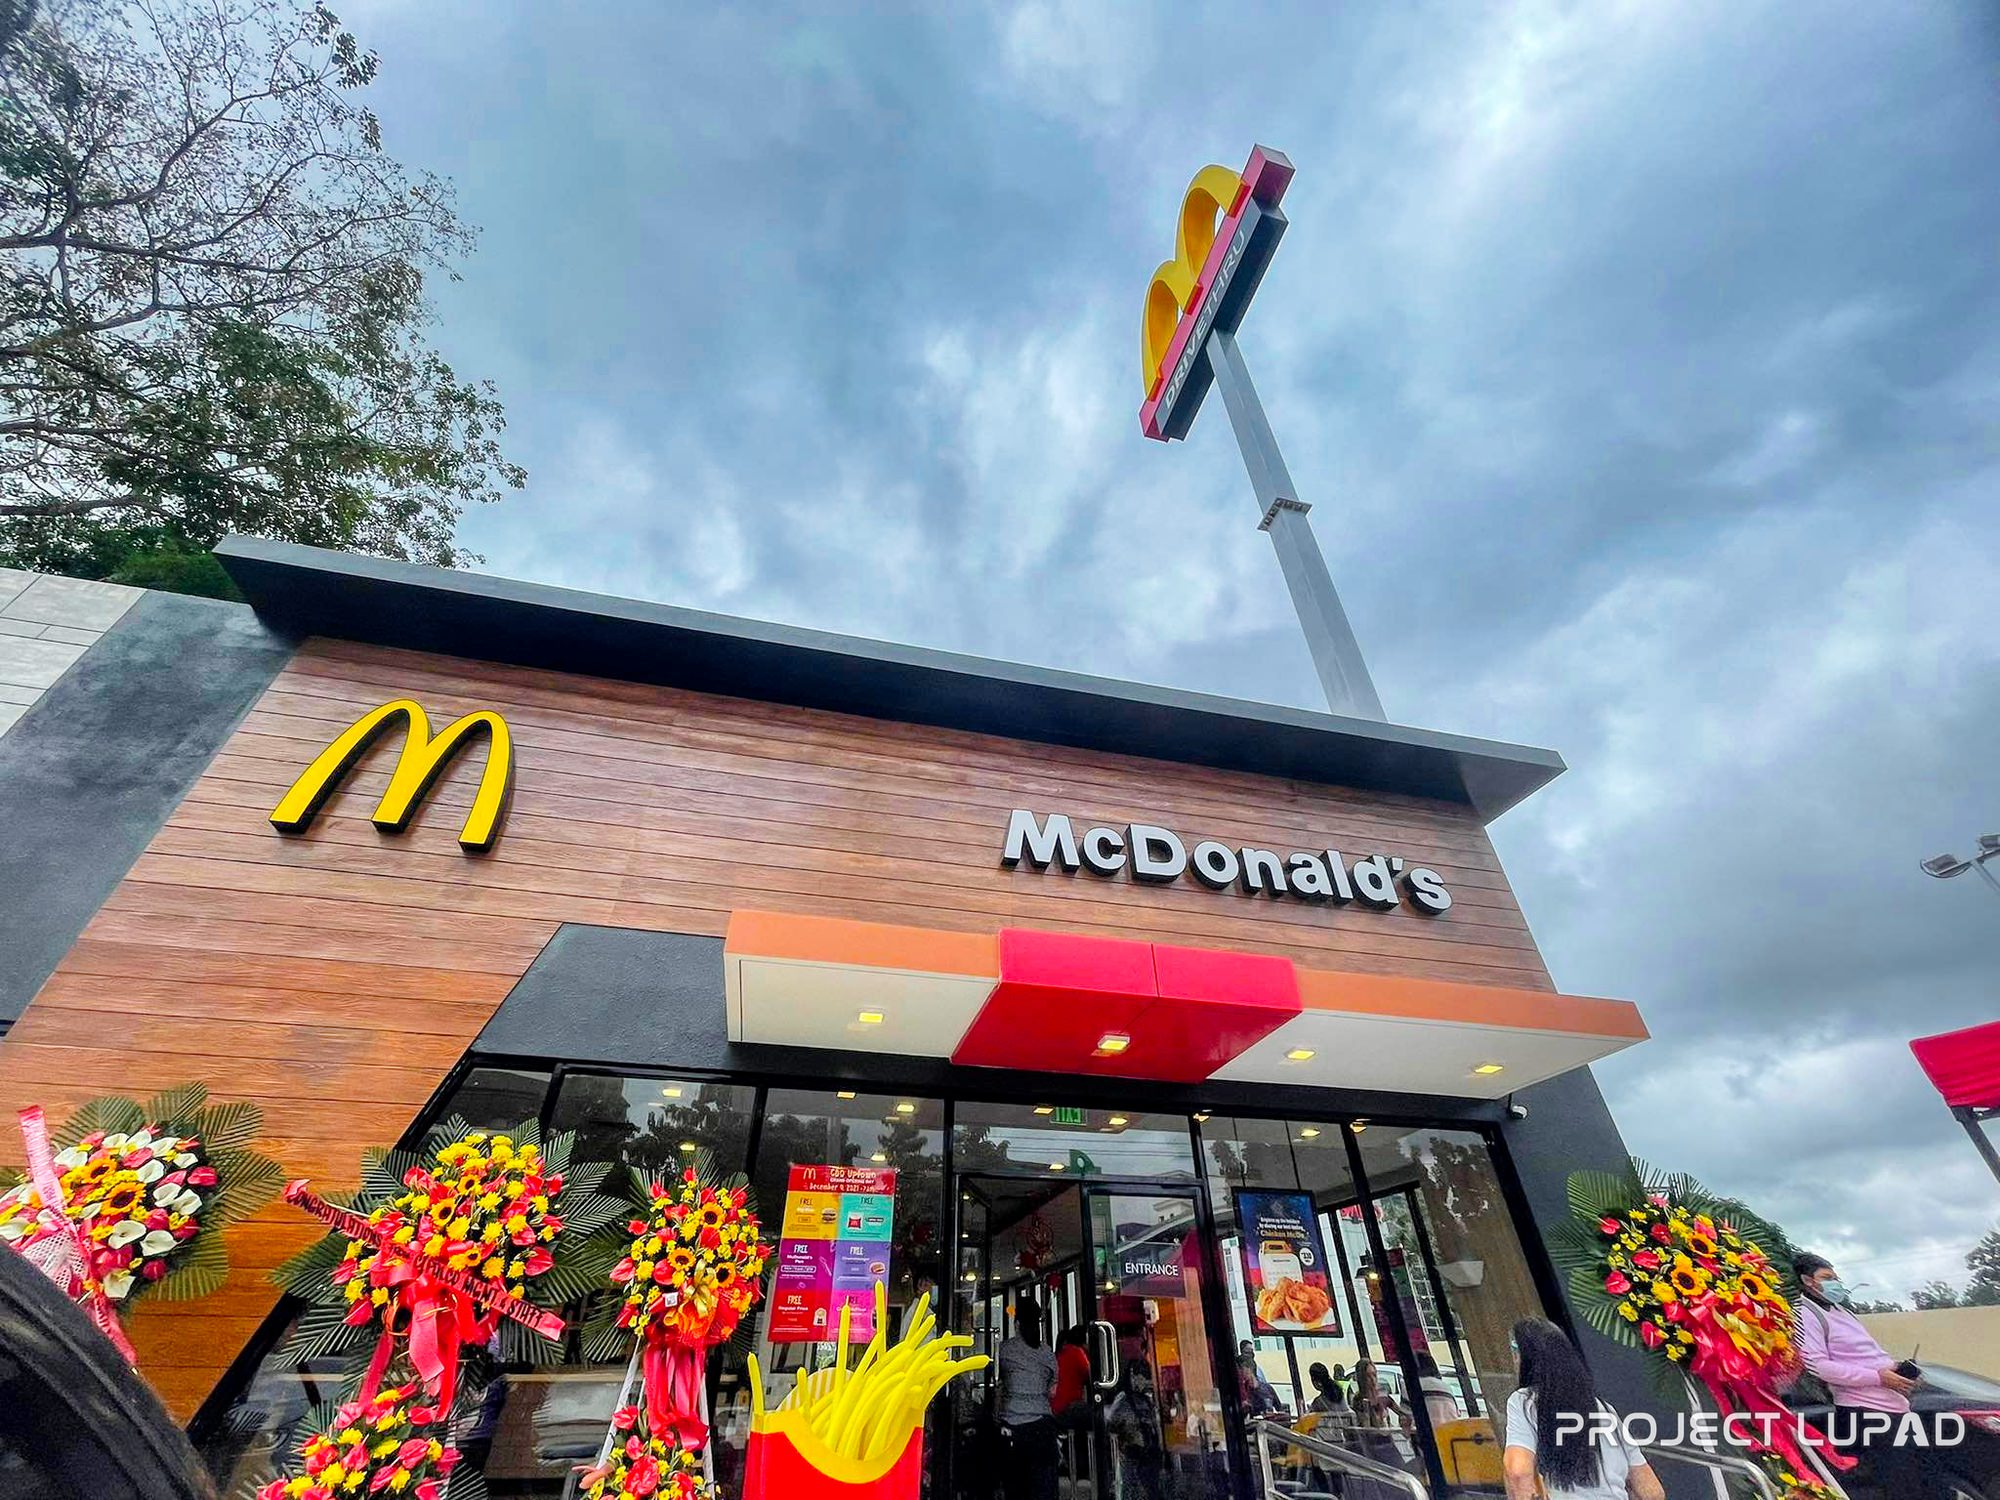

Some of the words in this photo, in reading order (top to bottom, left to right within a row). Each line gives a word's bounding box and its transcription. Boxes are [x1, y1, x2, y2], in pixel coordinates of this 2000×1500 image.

[1165, 318, 1208, 410] DRIVE
[1206, 229, 1246, 318] THRU
[1002, 809, 1454, 914] McDonald's
[809, 1182, 838, 1191] December
[793, 1244, 808, 1254] FREE
[849, 1246, 864, 1256] FREE
[1125, 1262, 1179, 1276] ENTRANCE
[787, 1295, 802, 1305] FREE
